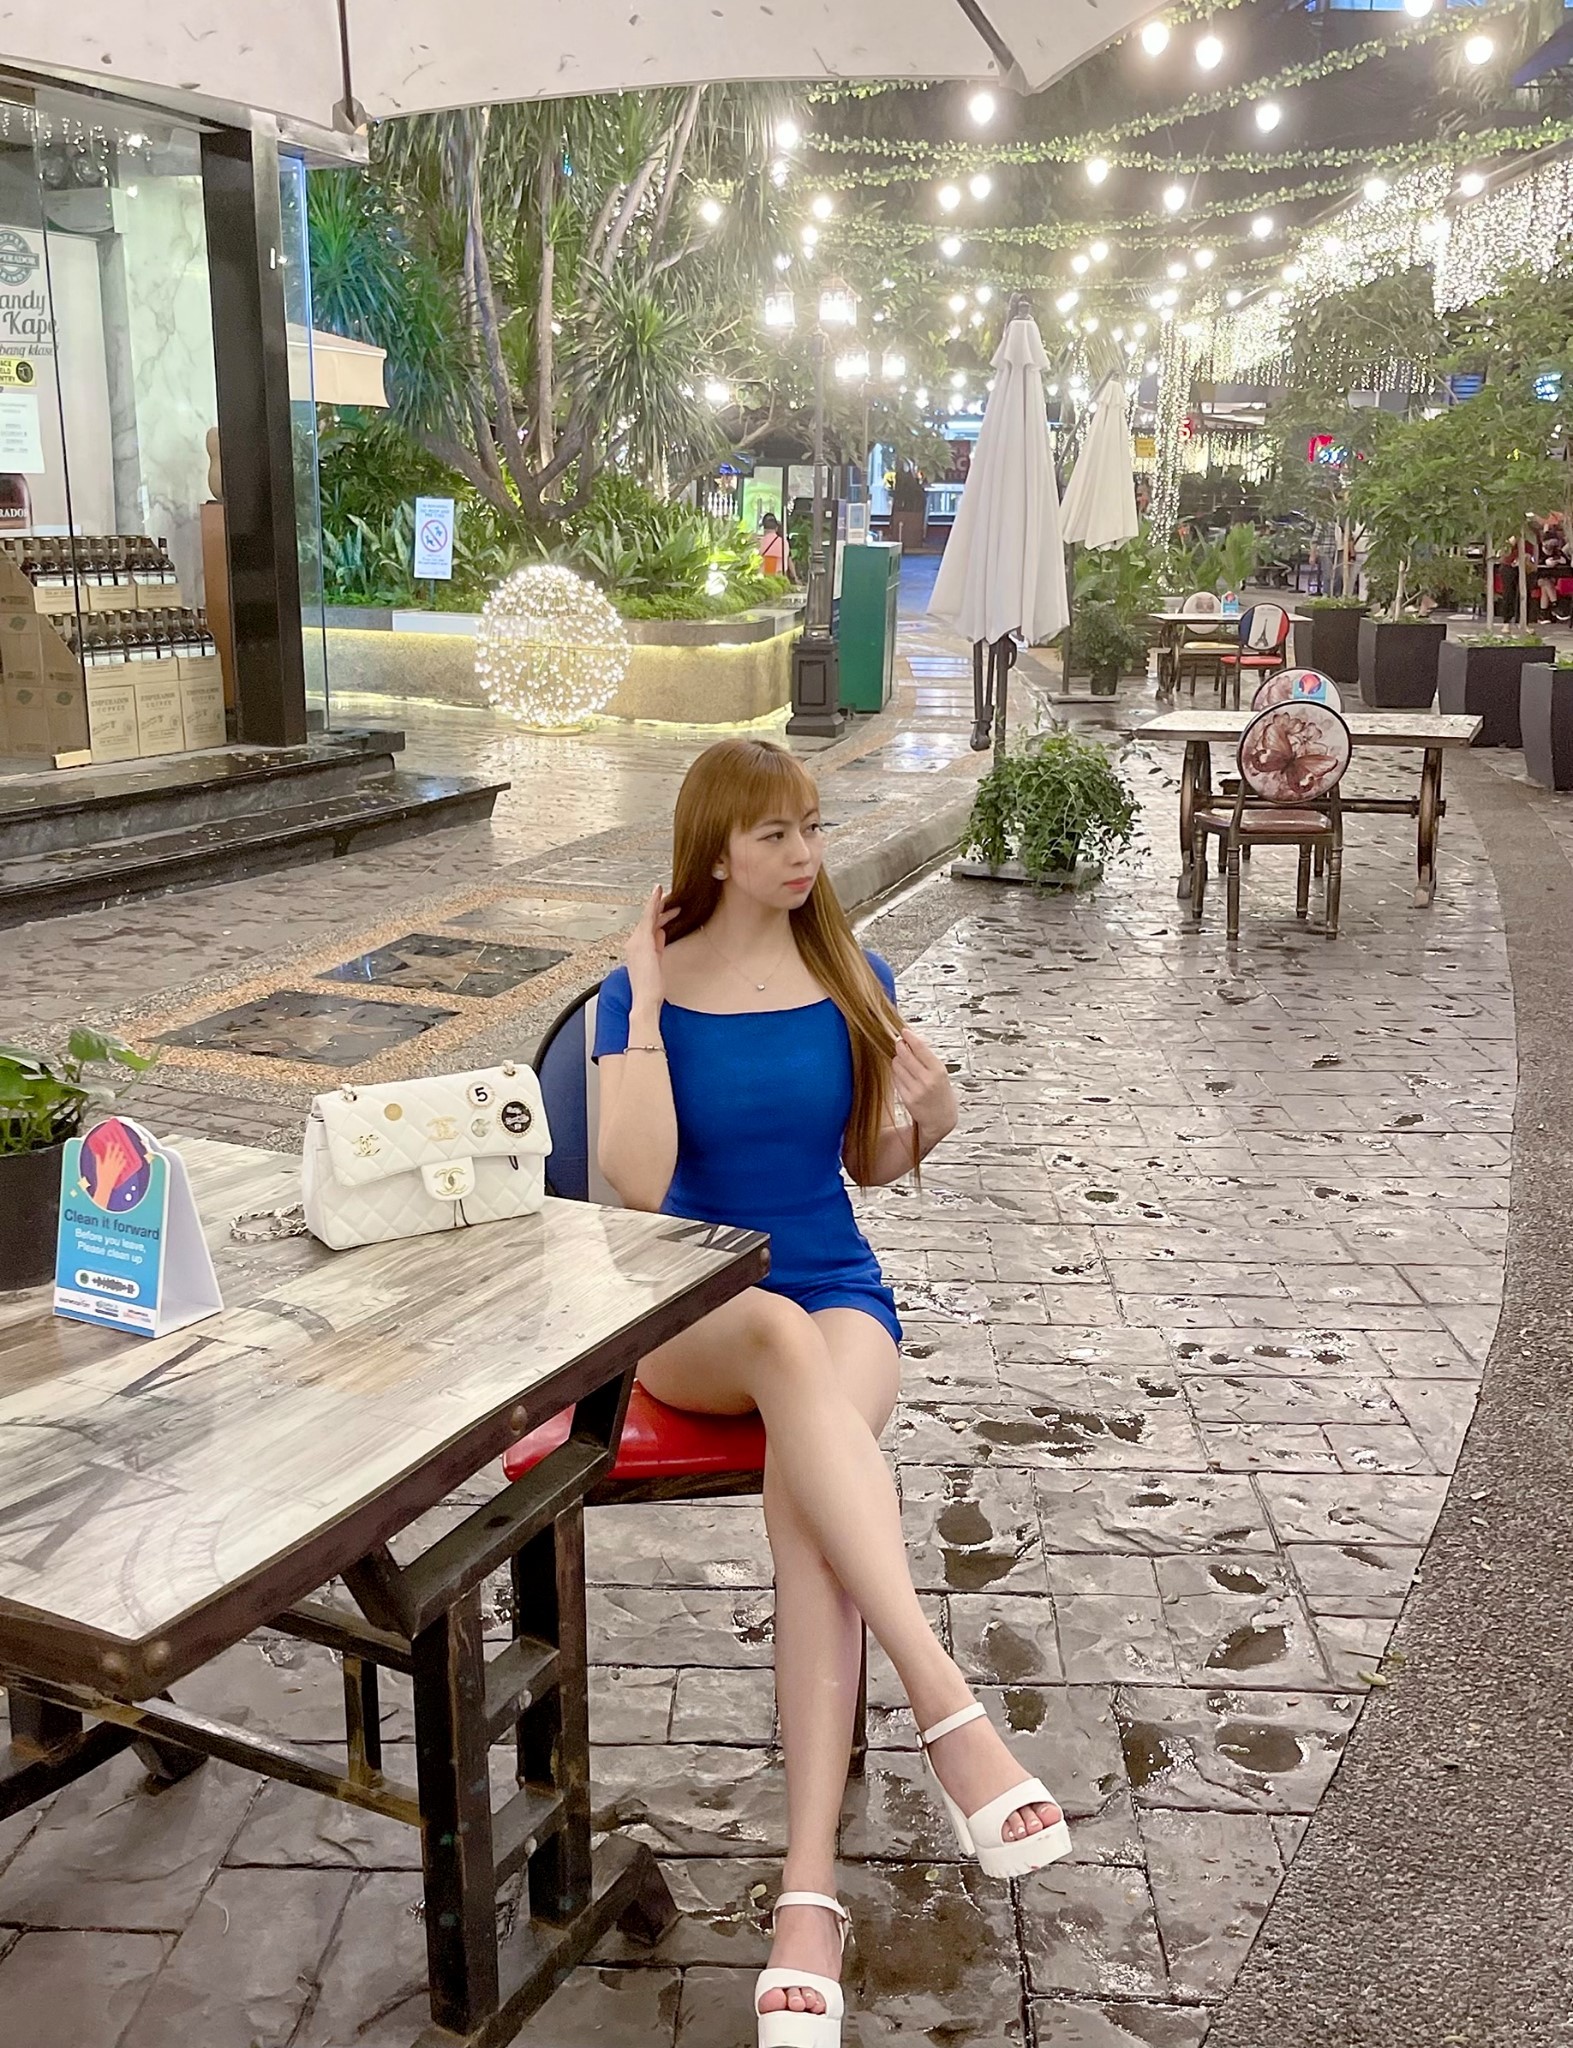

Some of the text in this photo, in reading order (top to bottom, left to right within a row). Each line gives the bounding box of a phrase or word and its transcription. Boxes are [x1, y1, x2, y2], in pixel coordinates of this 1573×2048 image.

[475, 1086, 488, 1102] 5
[64, 1208, 160, 1240] Clean it forward
[75, 1227, 146, 1253] Before you leave,
[77, 1240, 143, 1265] Please clean up
